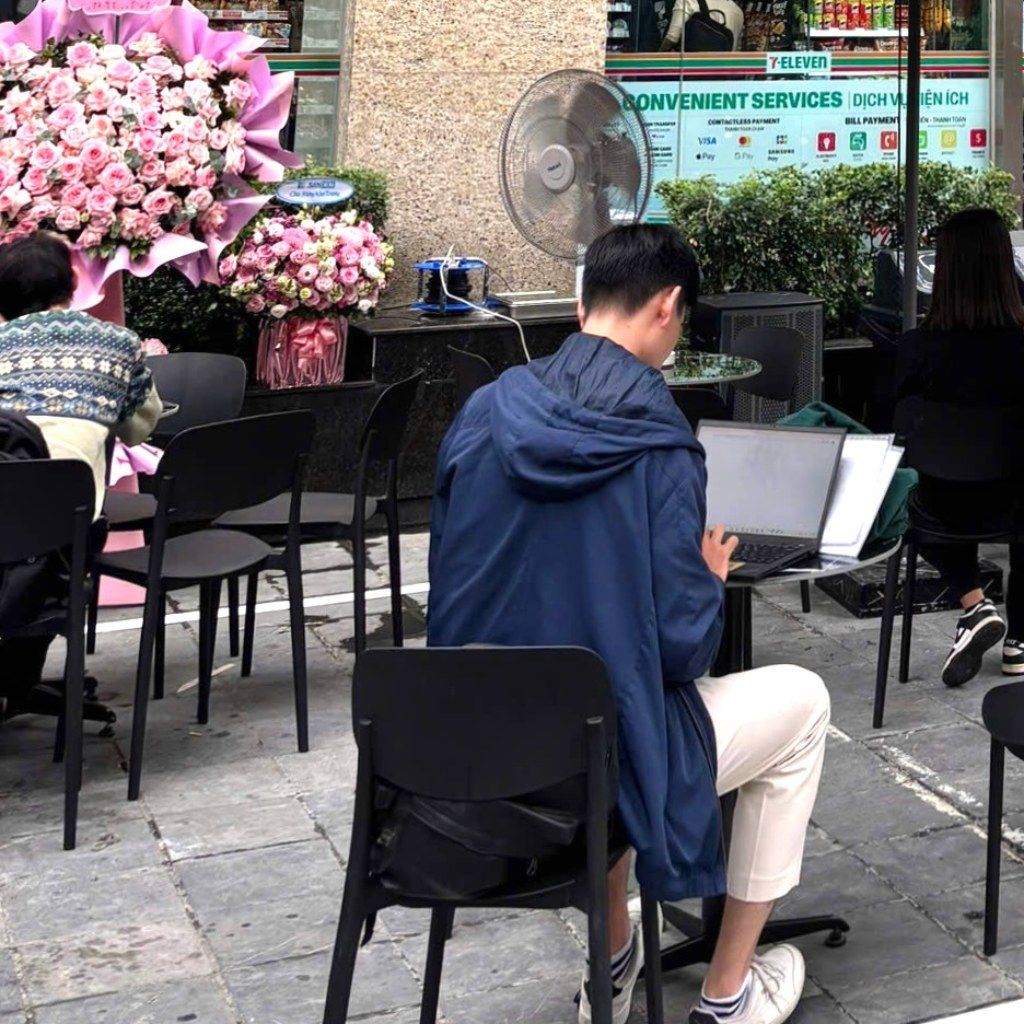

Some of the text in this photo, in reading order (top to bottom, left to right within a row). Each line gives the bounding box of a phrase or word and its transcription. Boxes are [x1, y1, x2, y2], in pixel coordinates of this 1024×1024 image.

[752, 90, 843, 109] SERVICES
[853, 92, 887, 110] DỊCH
[946, 90, 969, 106] ÍCH
[845, 116, 900, 125] BILL PAYMENT
[698, 137, 717, 145] VISA
